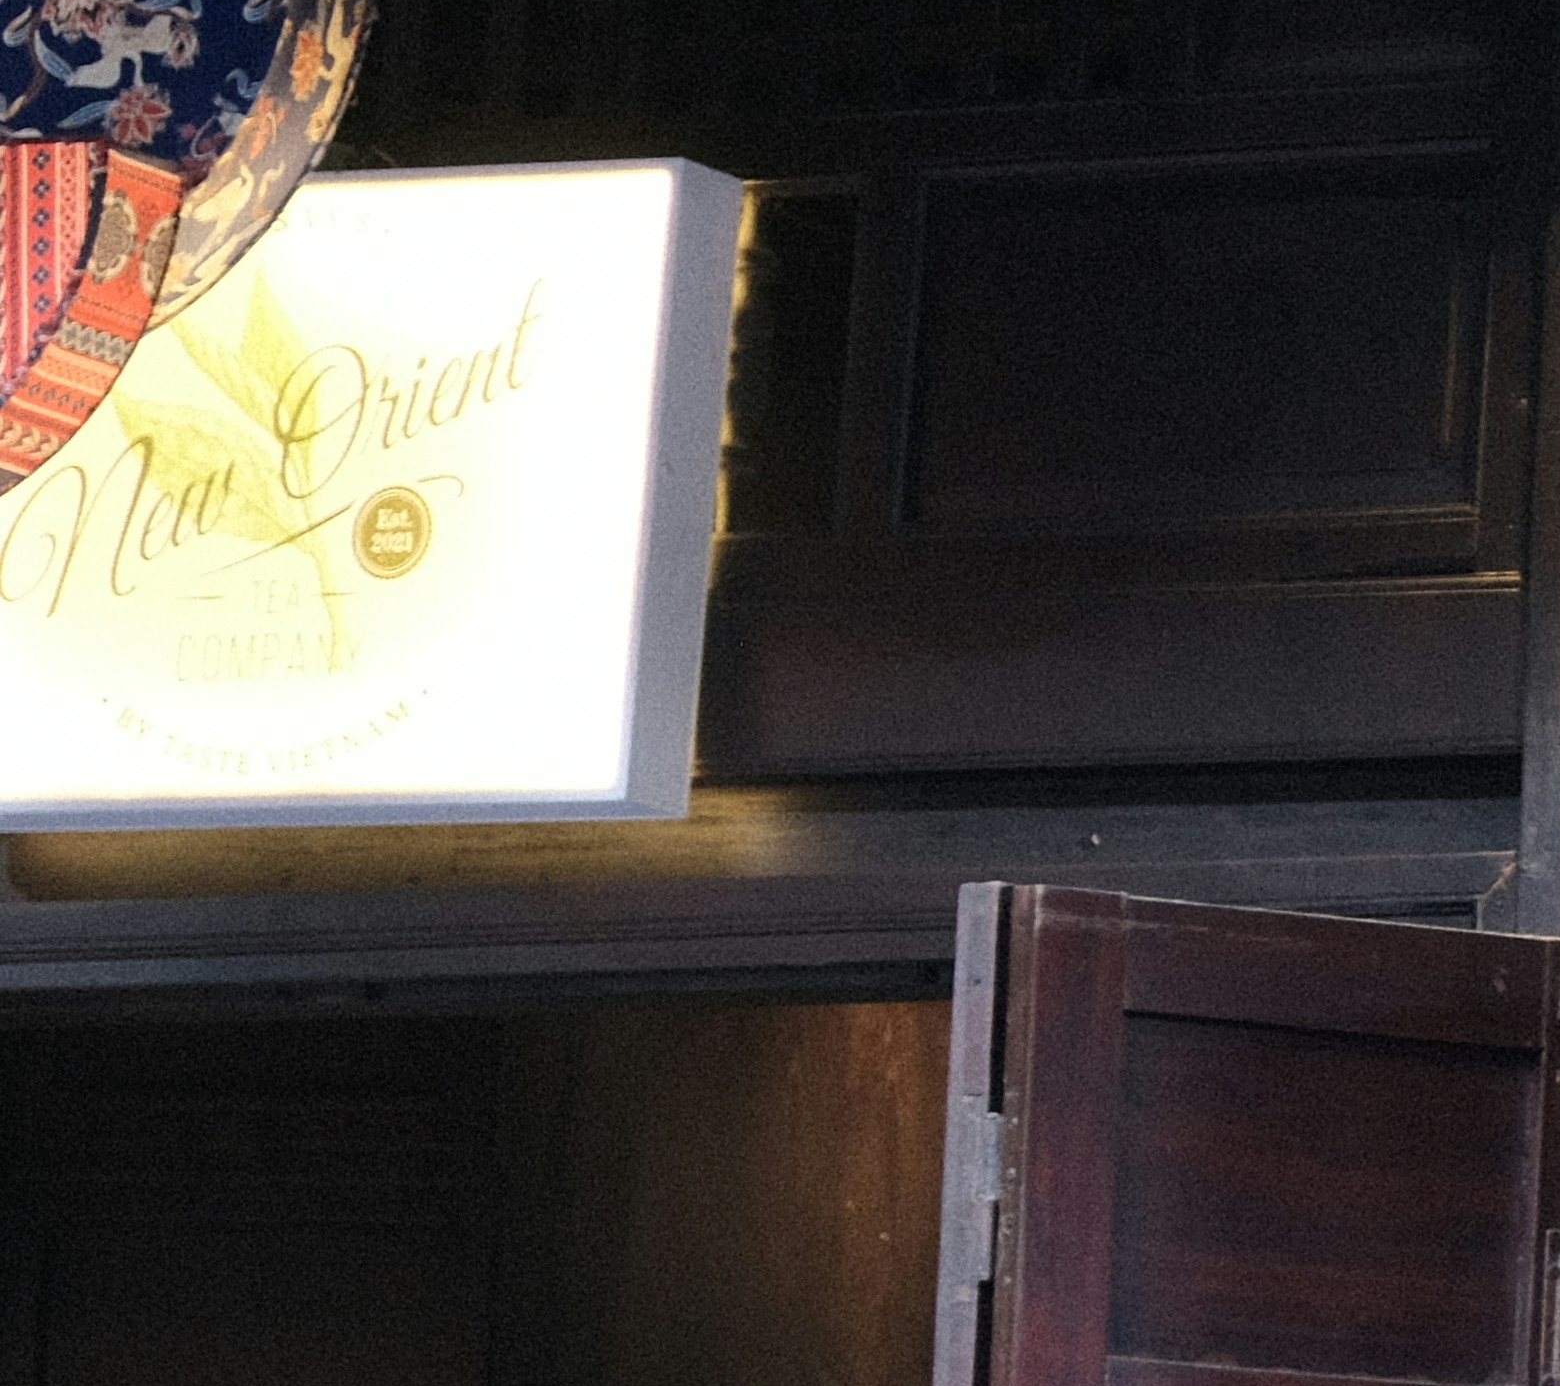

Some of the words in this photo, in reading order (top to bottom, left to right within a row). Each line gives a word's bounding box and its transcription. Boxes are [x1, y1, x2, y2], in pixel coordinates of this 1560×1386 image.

[0, 436, 236, 617] New
[272, 277, 547, 499] Orient
[251, 578, 302, 614] TEA
[174, 631, 366, 683] COMPANY
[163, 732, 252, 776] TASTE
[267, 700, 411, 773] VIETNAM
